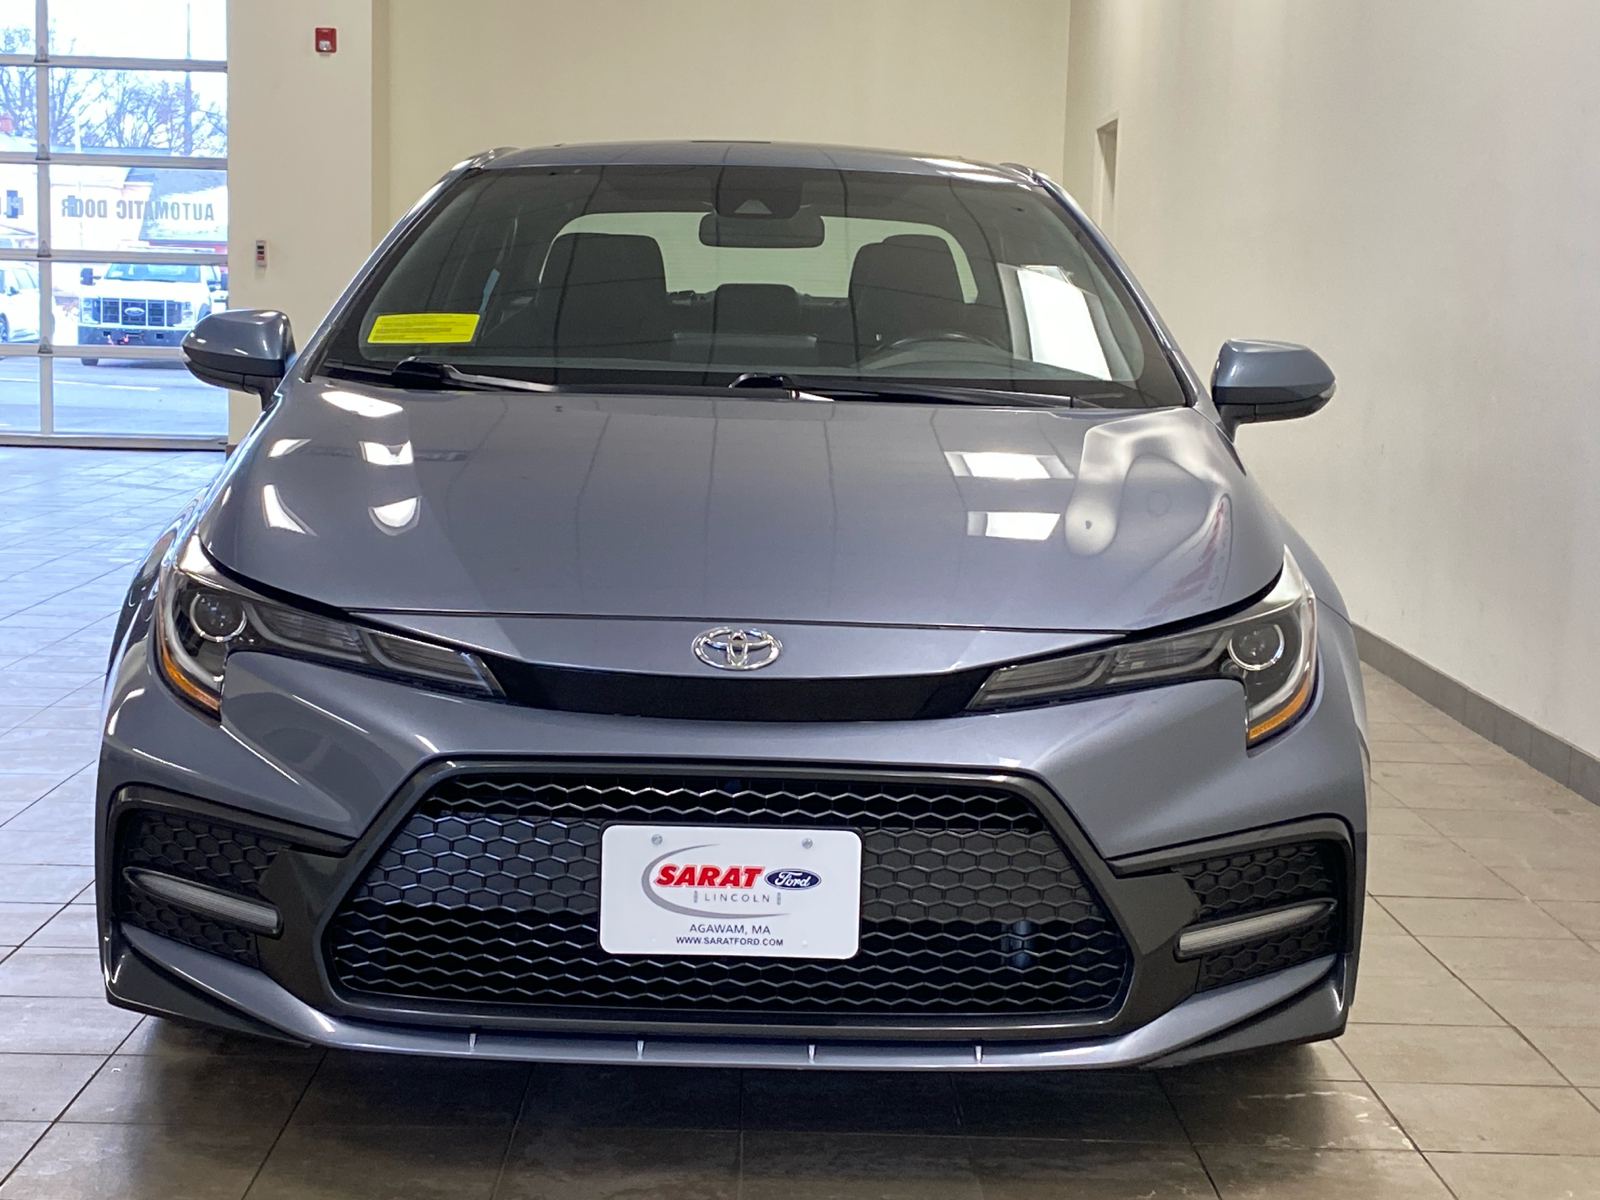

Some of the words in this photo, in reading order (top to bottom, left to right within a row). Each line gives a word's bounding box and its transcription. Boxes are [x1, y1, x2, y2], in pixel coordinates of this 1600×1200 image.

[655, 864, 764, 889] SARAT
[775, 871, 811, 887] Ford
[704, 893, 770, 903] LINCOLN
[689, 924, 748, 935] AGAWAM,
[752, 925, 771, 935] MA
[676, 936, 784, 946] WWW.SARATFORD.COM
